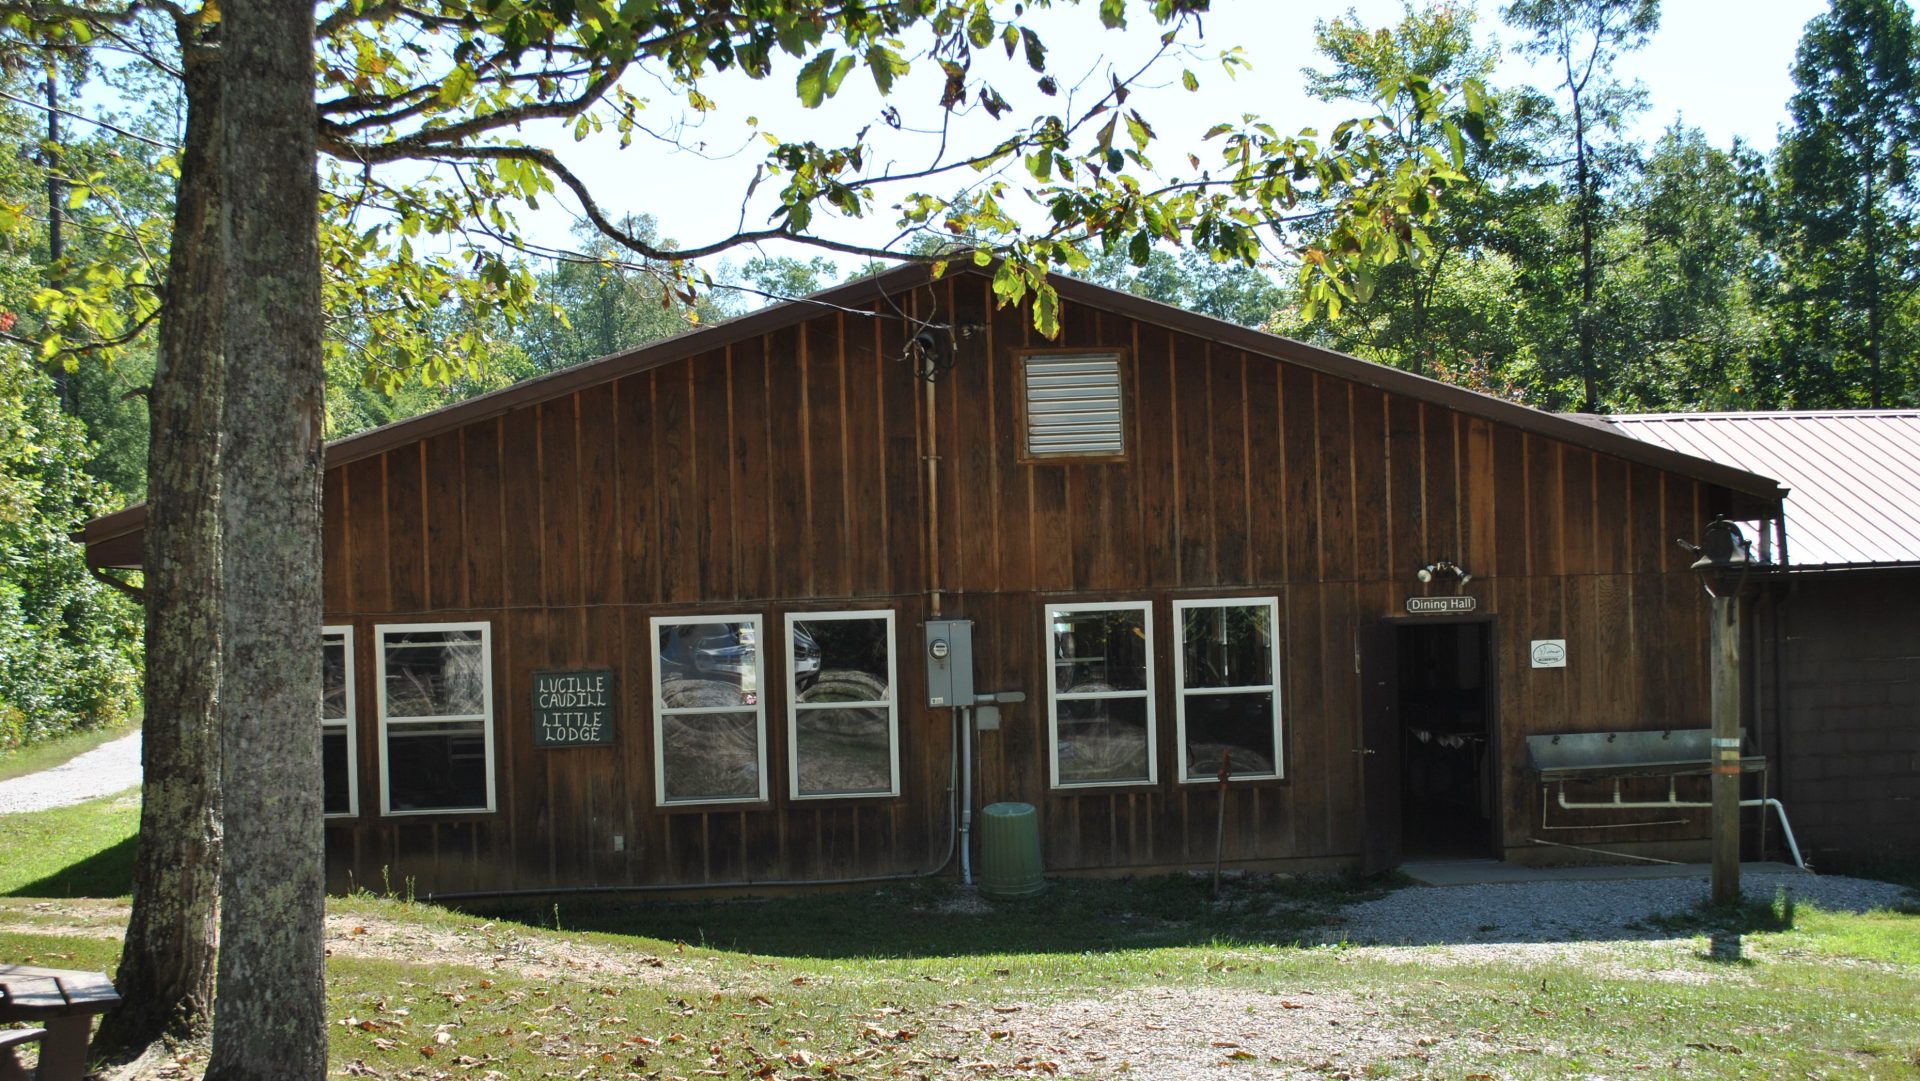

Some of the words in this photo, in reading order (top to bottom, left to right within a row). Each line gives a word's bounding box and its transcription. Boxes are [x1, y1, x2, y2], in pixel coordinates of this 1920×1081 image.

[1412, 599, 1447, 611] Dining
[1450, 598, 1471, 609] Hall
[539, 676, 605, 693] LUCILLE
[539, 692, 606, 708] CAUDILL
[542, 711, 602, 727] LITTLE
[545, 727, 600, 741] LODGE
